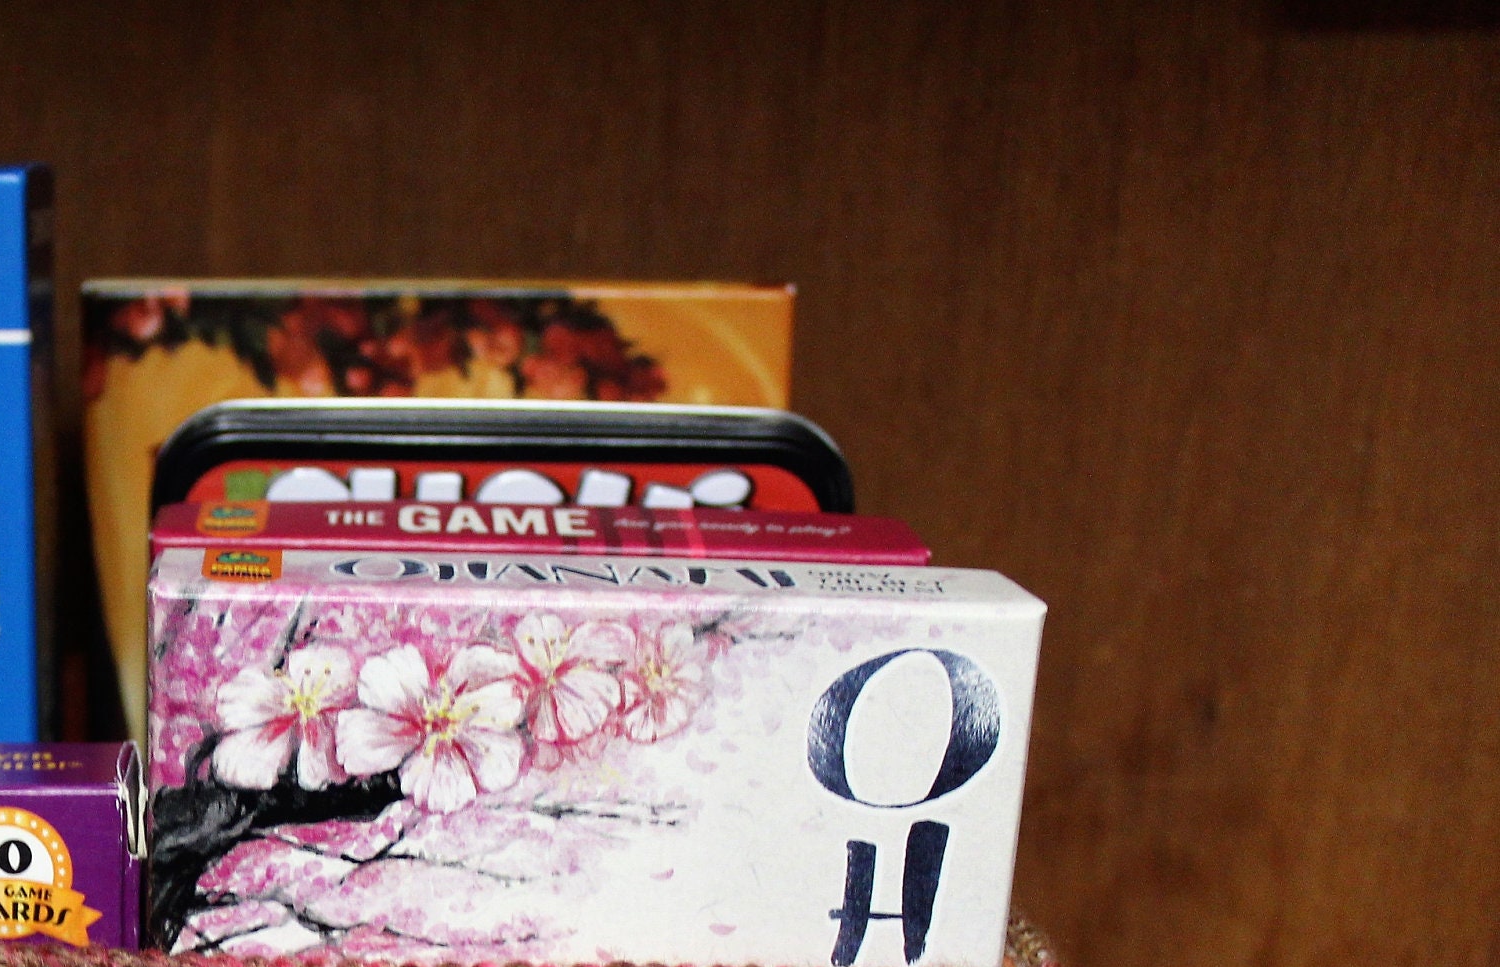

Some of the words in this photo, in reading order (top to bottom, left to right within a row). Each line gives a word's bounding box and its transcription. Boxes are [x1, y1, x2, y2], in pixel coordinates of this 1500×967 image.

[327, 509, 385, 526] THE
[398, 505, 596, 537] GAME
[4, 884, 53, 901] GAME
